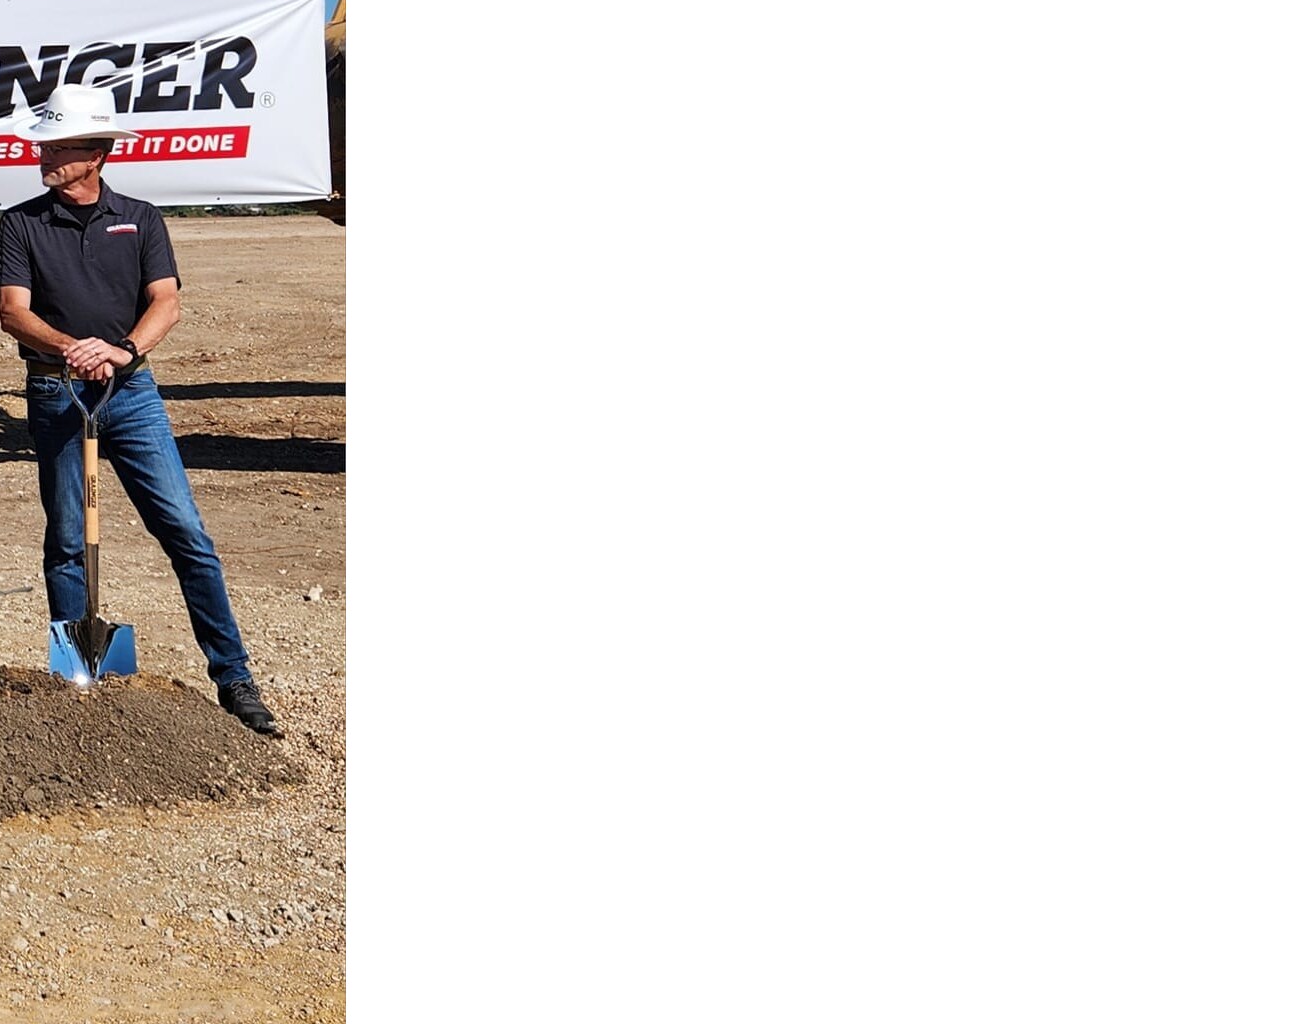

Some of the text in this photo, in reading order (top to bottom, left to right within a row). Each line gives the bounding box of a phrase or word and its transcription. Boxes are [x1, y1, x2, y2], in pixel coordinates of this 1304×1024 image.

[43, 110, 63, 121] TDC
[109, 138, 139, 155] ET
[143, 136, 168, 154] IT
[169, 133, 235, 154] DONE
